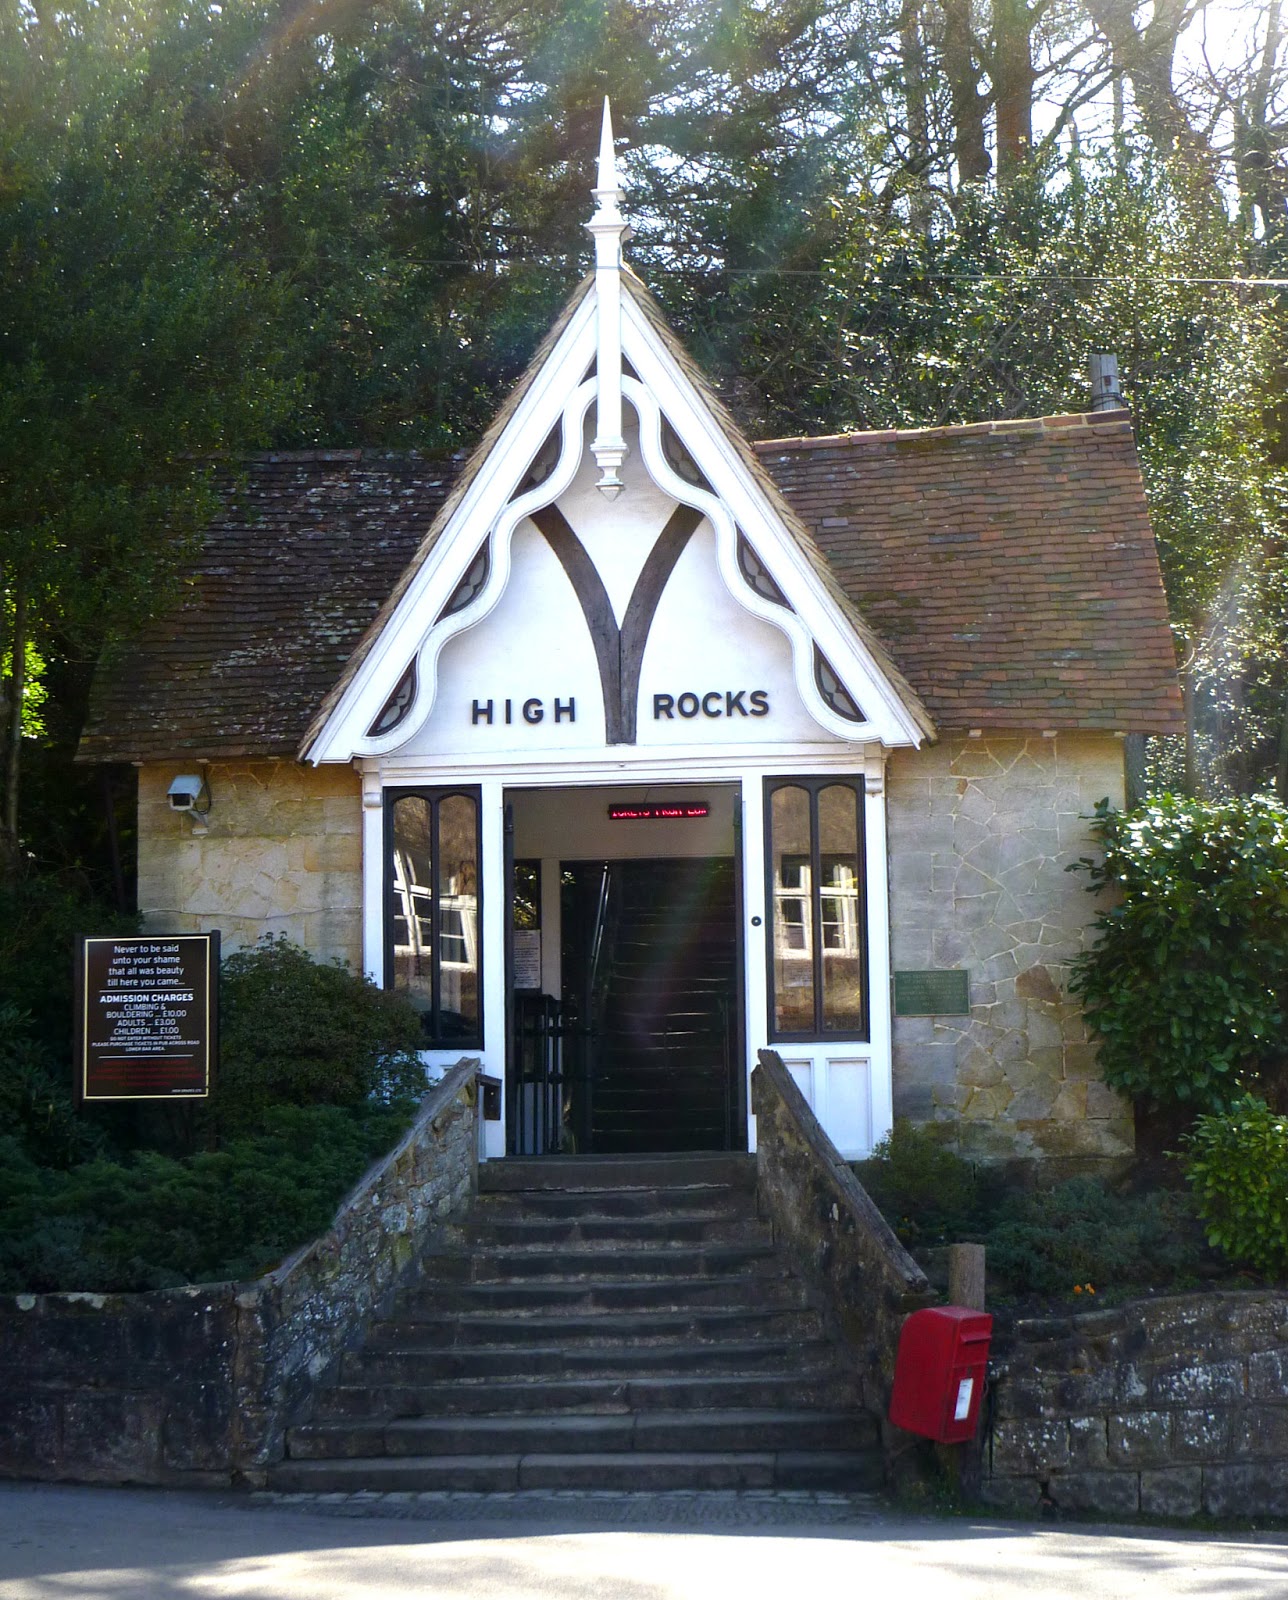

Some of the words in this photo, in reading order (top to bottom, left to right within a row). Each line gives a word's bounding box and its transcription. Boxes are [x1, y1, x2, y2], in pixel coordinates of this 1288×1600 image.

[471, 697, 576, 725] HIGH
[653, 690, 770, 720] ROCKS
[114, 945, 138, 953] Never
[140, 945, 148, 953] to
[163, 944, 179, 952] said
[133, 957, 151, 965] your
[128, 967, 137, 975] all
[156, 967, 184, 975] beauty
[120, 978, 137, 986] here
[140, 979, 155, 987] you
[100, 994, 149, 1003] ADMISSION
[151, 993, 194, 1002] CHARGES
[124, 1003, 159, 1011] CLIMBING
[114, 1027, 151, 1035] CHILDREN
